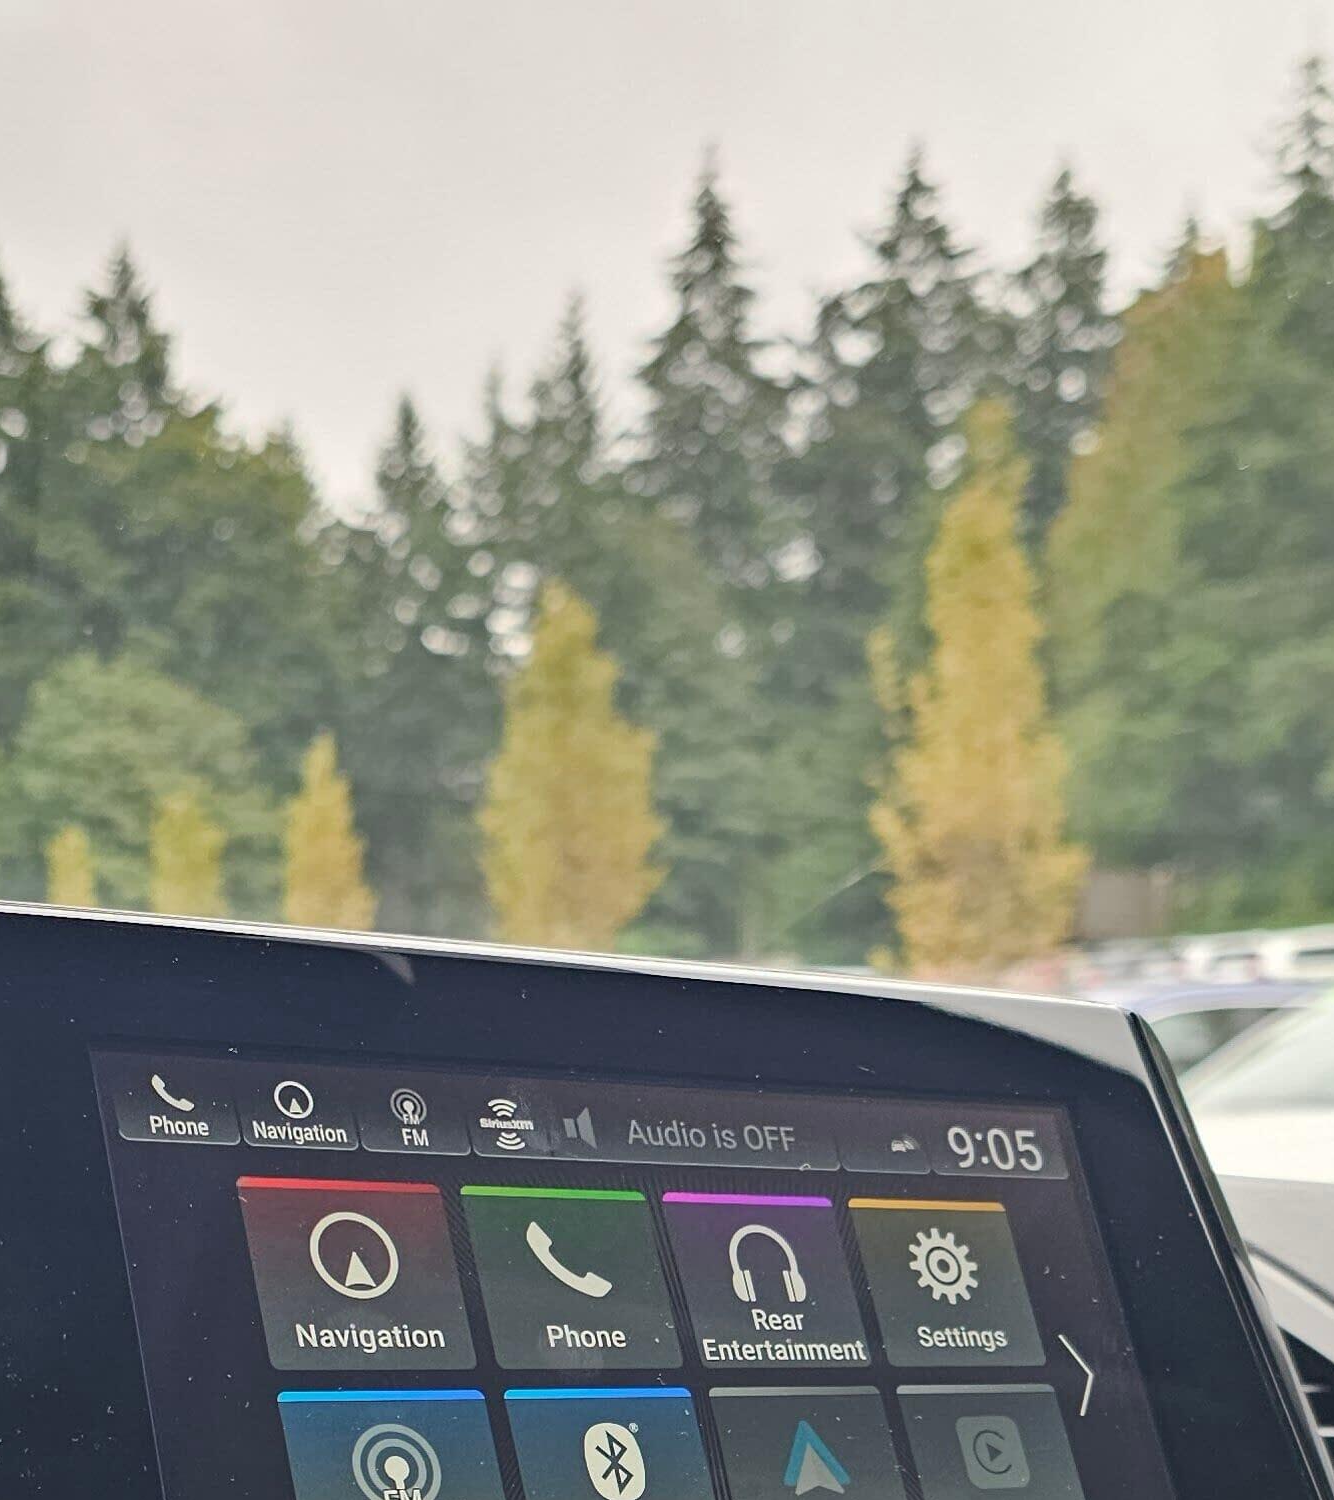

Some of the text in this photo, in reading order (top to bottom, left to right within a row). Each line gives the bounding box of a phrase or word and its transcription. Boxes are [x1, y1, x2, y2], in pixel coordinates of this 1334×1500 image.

[149, 1115, 210, 1138] Phone
[252, 1119, 348, 1144] Navigation
[402, 1128, 429, 1147] FM
[627, 1121, 795, 1152] Audio is OFF
[947, 1126, 1043, 1173] 9:05
[752, 1309, 804, 1333] Rear
[295, 1323, 446, 1353] Navigation
[547, 1323, 627, 1349] Phone
[917, 1325, 1008, 1353] Settings
[703, 1338, 865, 1363] Entertainment
